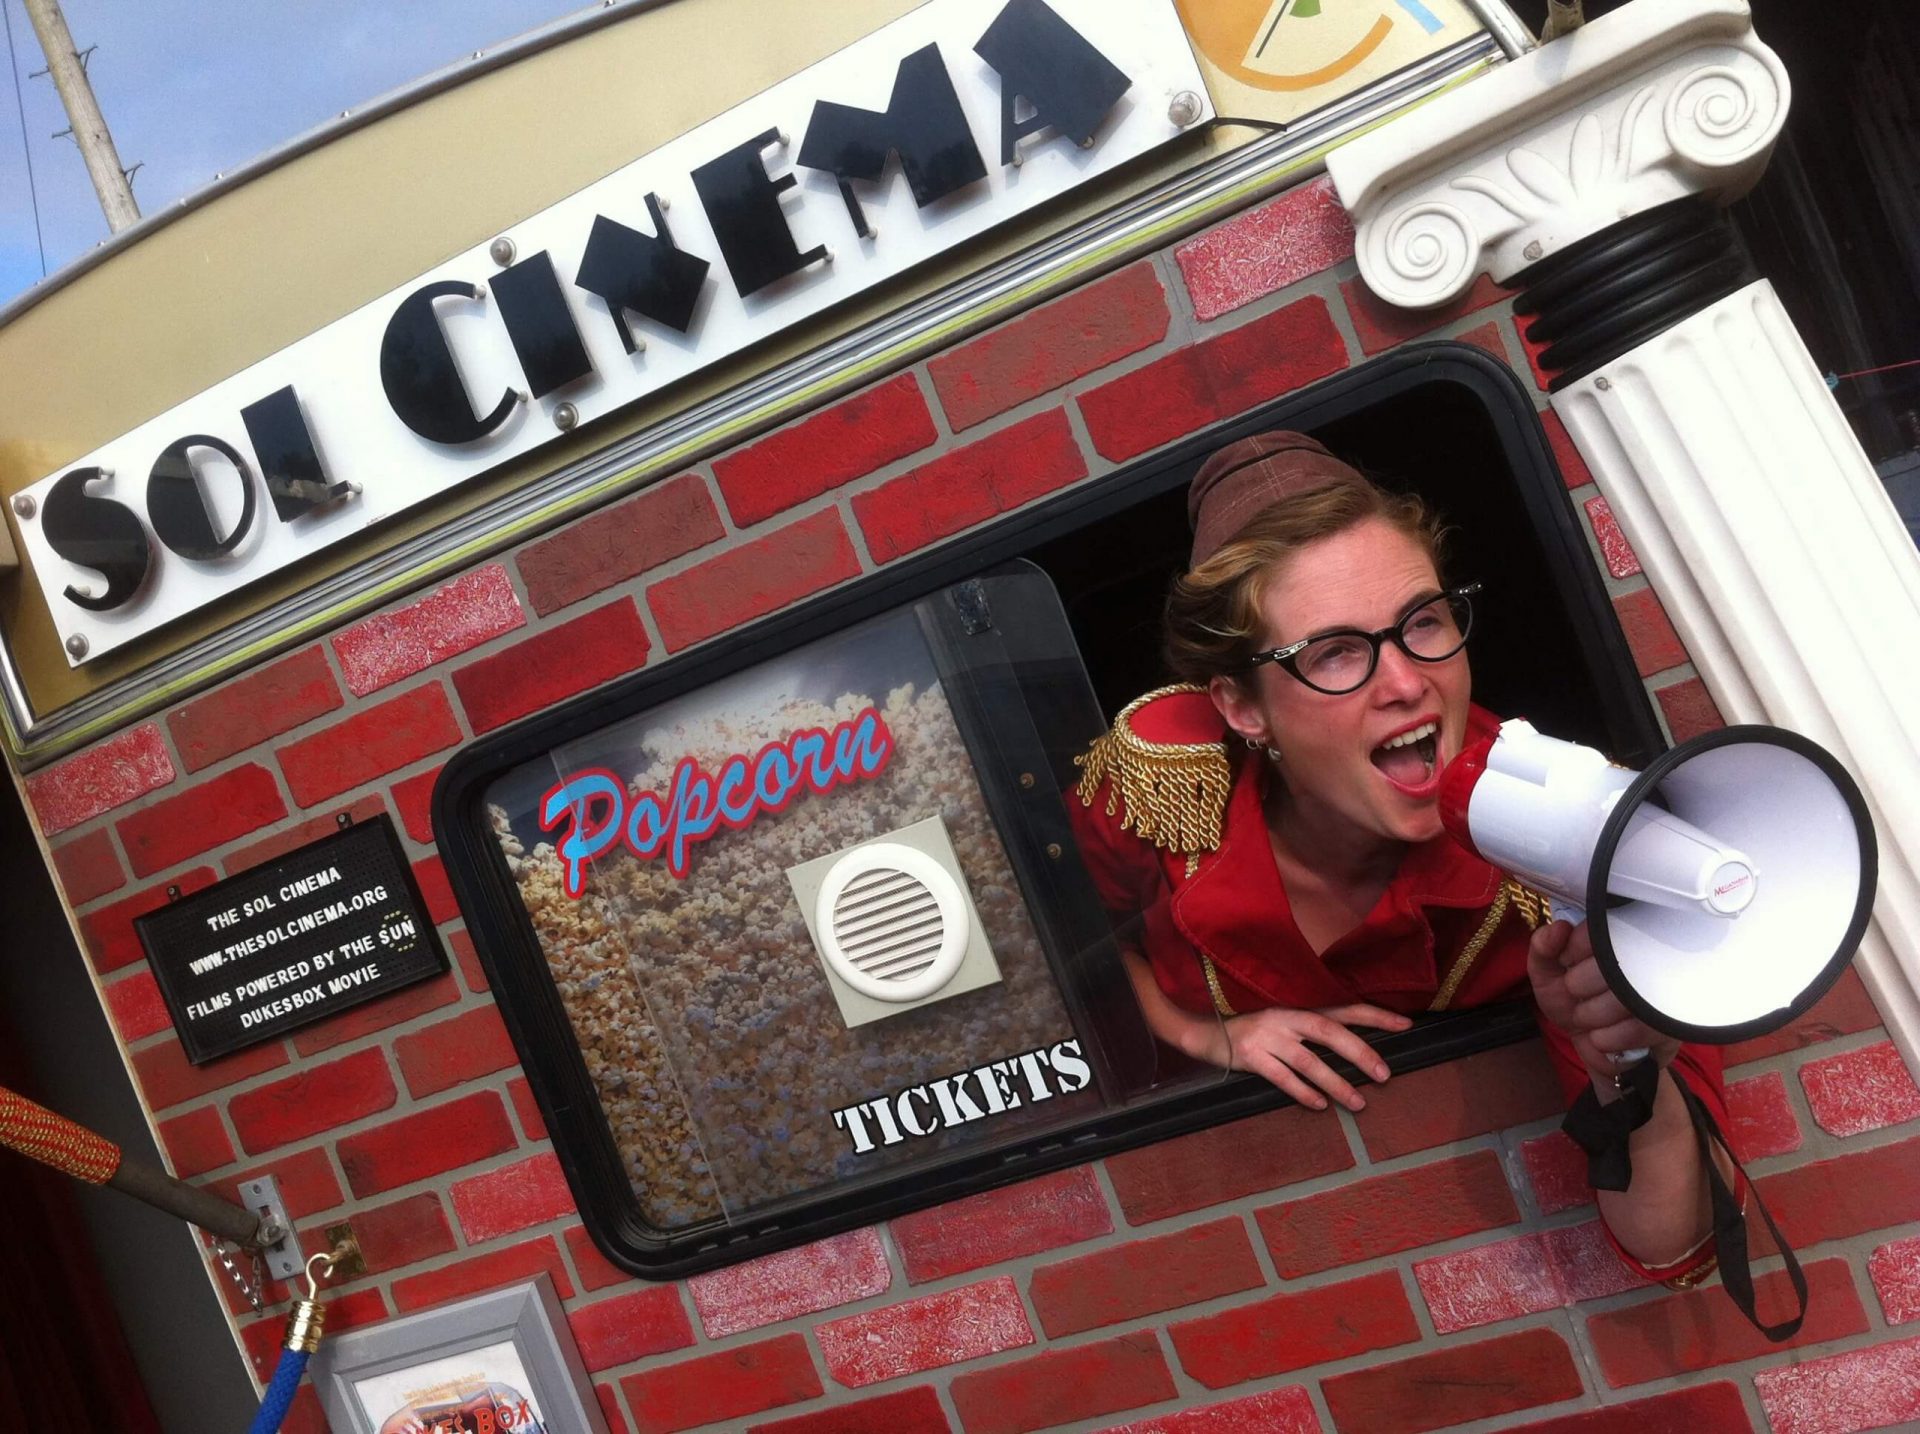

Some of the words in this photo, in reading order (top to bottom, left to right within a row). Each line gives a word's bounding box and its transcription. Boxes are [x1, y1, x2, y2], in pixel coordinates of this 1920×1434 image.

[41, 384, 358, 611] SOL
[380, 0, 1132, 444] CINEMA
[540, 708, 893, 897] Popcorn
[189, 885, 388, 976] WWW.THESOLCINEMA.ORG
[206, 908, 240, 932] THE
[242, 894, 276, 918] SOL
[279, 866, 342, 902] CINEMA
[186, 991, 232, 1021] FILMS
[236, 961, 311, 1001] POWERED
[314, 949, 336, 972] BY
[339, 935, 376, 960] THE
[378, 919, 416, 945] SUN
[239, 984, 327, 1029] DUKESBOX
[328, 963, 381, 995] MOVIE
[832, 1039, 1092, 1156] TICKETS
[474, 1399, 529, 1434] BOX
